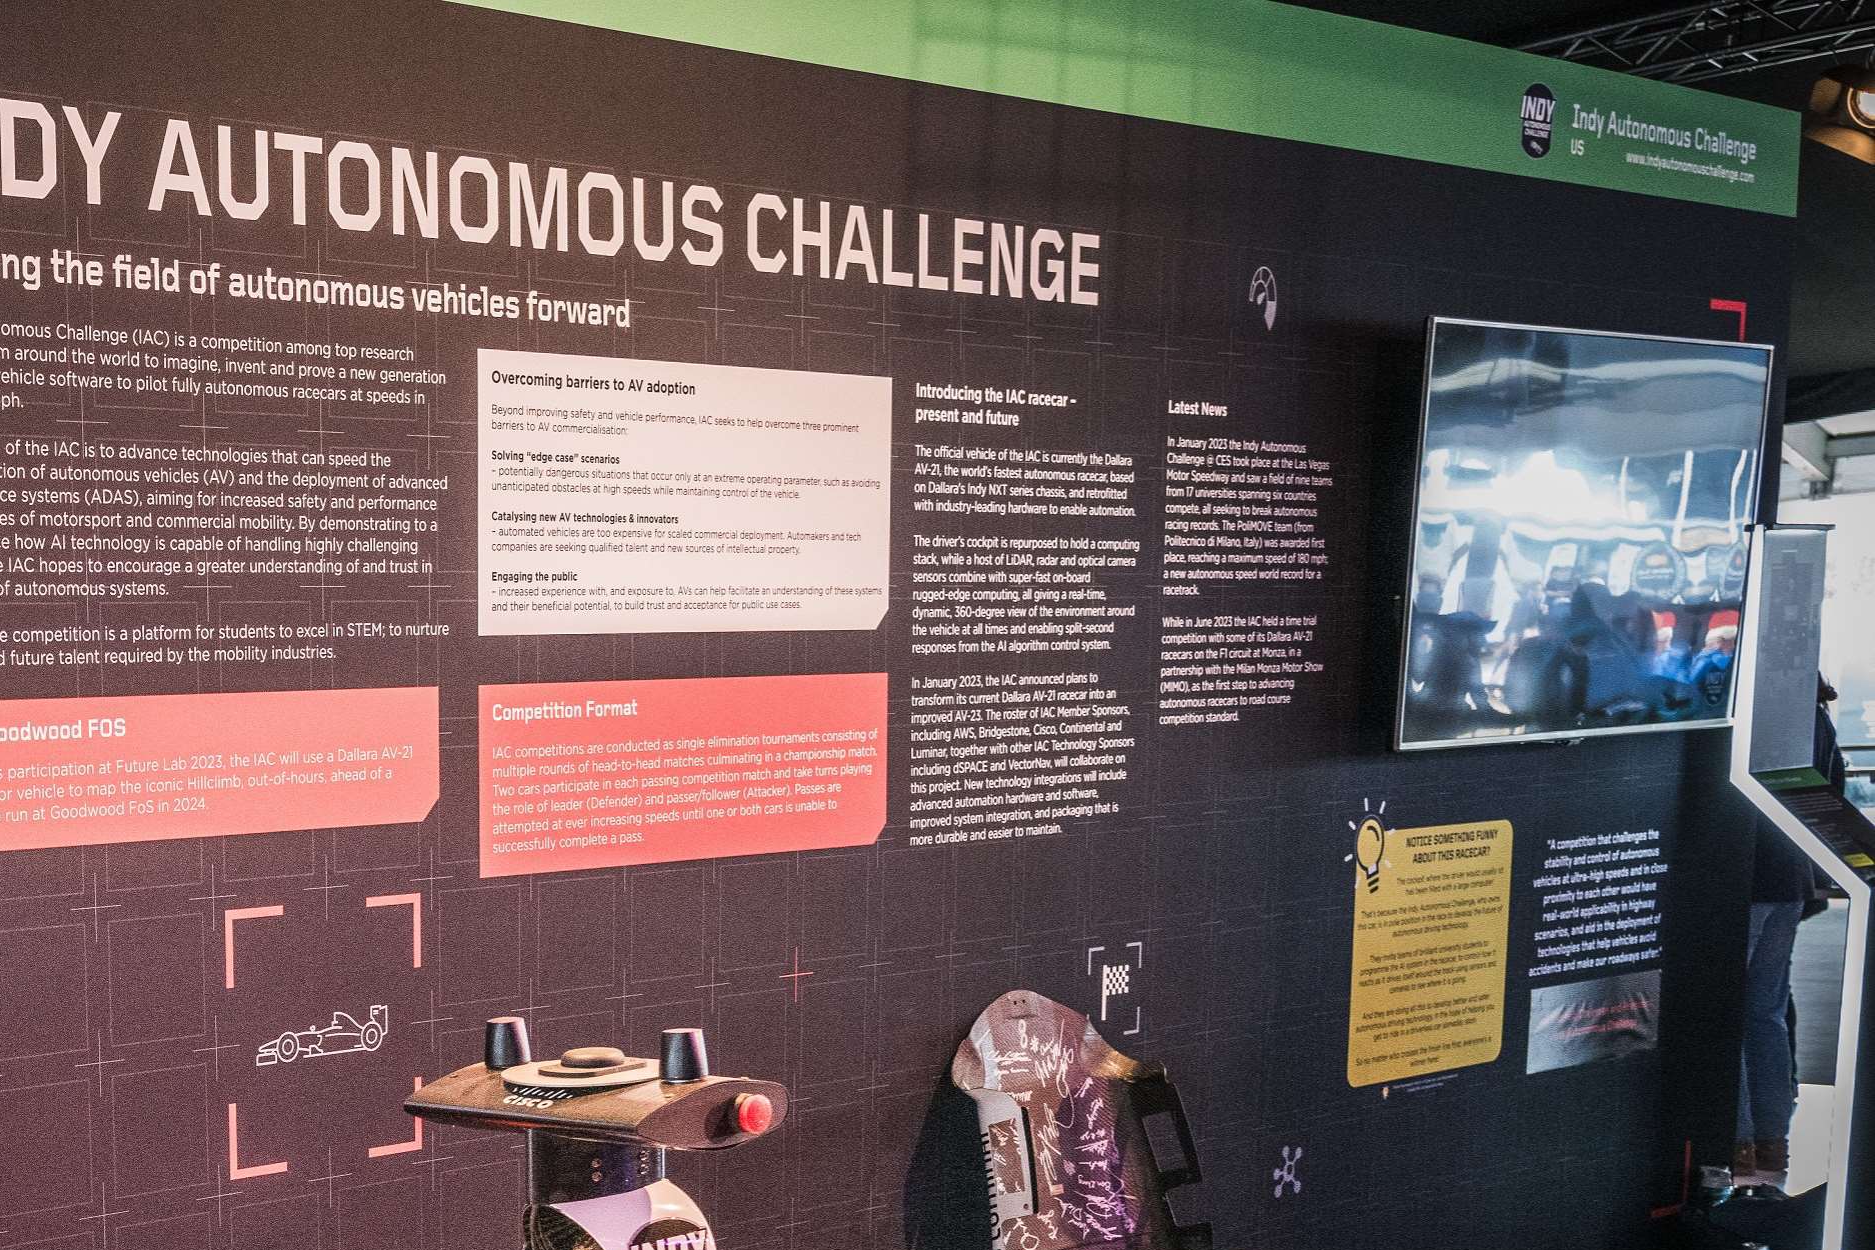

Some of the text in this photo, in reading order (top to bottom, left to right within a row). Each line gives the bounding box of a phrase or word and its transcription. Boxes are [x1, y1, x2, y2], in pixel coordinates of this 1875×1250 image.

[1520, 95, 1556, 123] INDY
[1571, 104, 1757, 164] Indy Autonomous Challenge
[1570, 139, 1585, 156] US
[148, 118, 723, 266] AUTONOMOUS
[747, 196, 1100, 307] CHALLENGE
[50, 249, 104, 286] the
[113, 254, 180, 292] field
[190, 263, 221, 295] of
[229, 268, 405, 309] autonomous
[411, 284, 520, 319] vehicles
[527, 291, 631, 328] forward
[56, 324, 127, 345] Challenge
[133, 329, 169, 348] (IAC)
[175, 335, 184, 346] is
[189, 336, 196, 347] a
[201, 337, 282, 353] competition
[286, 343, 331, 358] among
[335, 343, 357, 360] top
[361, 347, 413, 361] research
[15, 347, 66, 362] around
[72, 348, 95, 364] the
[100, 351, 139, 367] world
[144, 354, 159, 368] to
[164, 354, 220, 374] imagine,
[226, 357, 266, 374] invent
[270, 361, 294, 375] and
[299, 366, 335, 378] prove
[339, 368, 346, 378] a
[350, 369, 376, 380] new
[380, 370, 446, 384] generation
[50, 371, 112, 388] software
[117, 375, 131, 389] to
[137, 376, 167, 392] pilot
[172, 377, 200, 396] fully
[205, 381, 288, 397] autonomous
[293, 388, 346, 401] racecars
[350, 388, 362, 401] at
[367, 390, 410, 404] speeds
[415, 390, 424, 404] in
[492, 371, 695, 396] Overcoming barriers to AV adoption
[916, 383, 982, 404] Introducing
[985, 387, 1003, 402] the
[1006, 389, 1025, 404] IAC
[1028, 394, 1068, 407] racecar
[916, 409, 1019, 426] present and future
[1168, 400, 1227, 416] Latest News
[492, 450, 619, 464] Solving “edge case” scenarios
[492, 512, 536, 523] Catalysing
[559, 513, 571, 522] AV
[574, 513, 626, 524] technologies
[629, 514, 634, 523] &
[637, 515, 678, 524] innovators
[492, 572, 577, 583] Engaging the public
[15, 581, 106, 597] autonomous
[109, 581, 170, 599] systems.
[493, 699, 637, 724] Competition Format
[89, 718, 125, 738] FOS
[6, 811, 27, 821] run
[33, 808, 45, 820] at
[51, 801, 124, 819] Goodwood
[129, 800, 154, 814] FoS
[159, 802, 169, 812] in
[173, 797, 210, 811] 2024.
[493, 833, 644, 853] successfully complete a pass.
